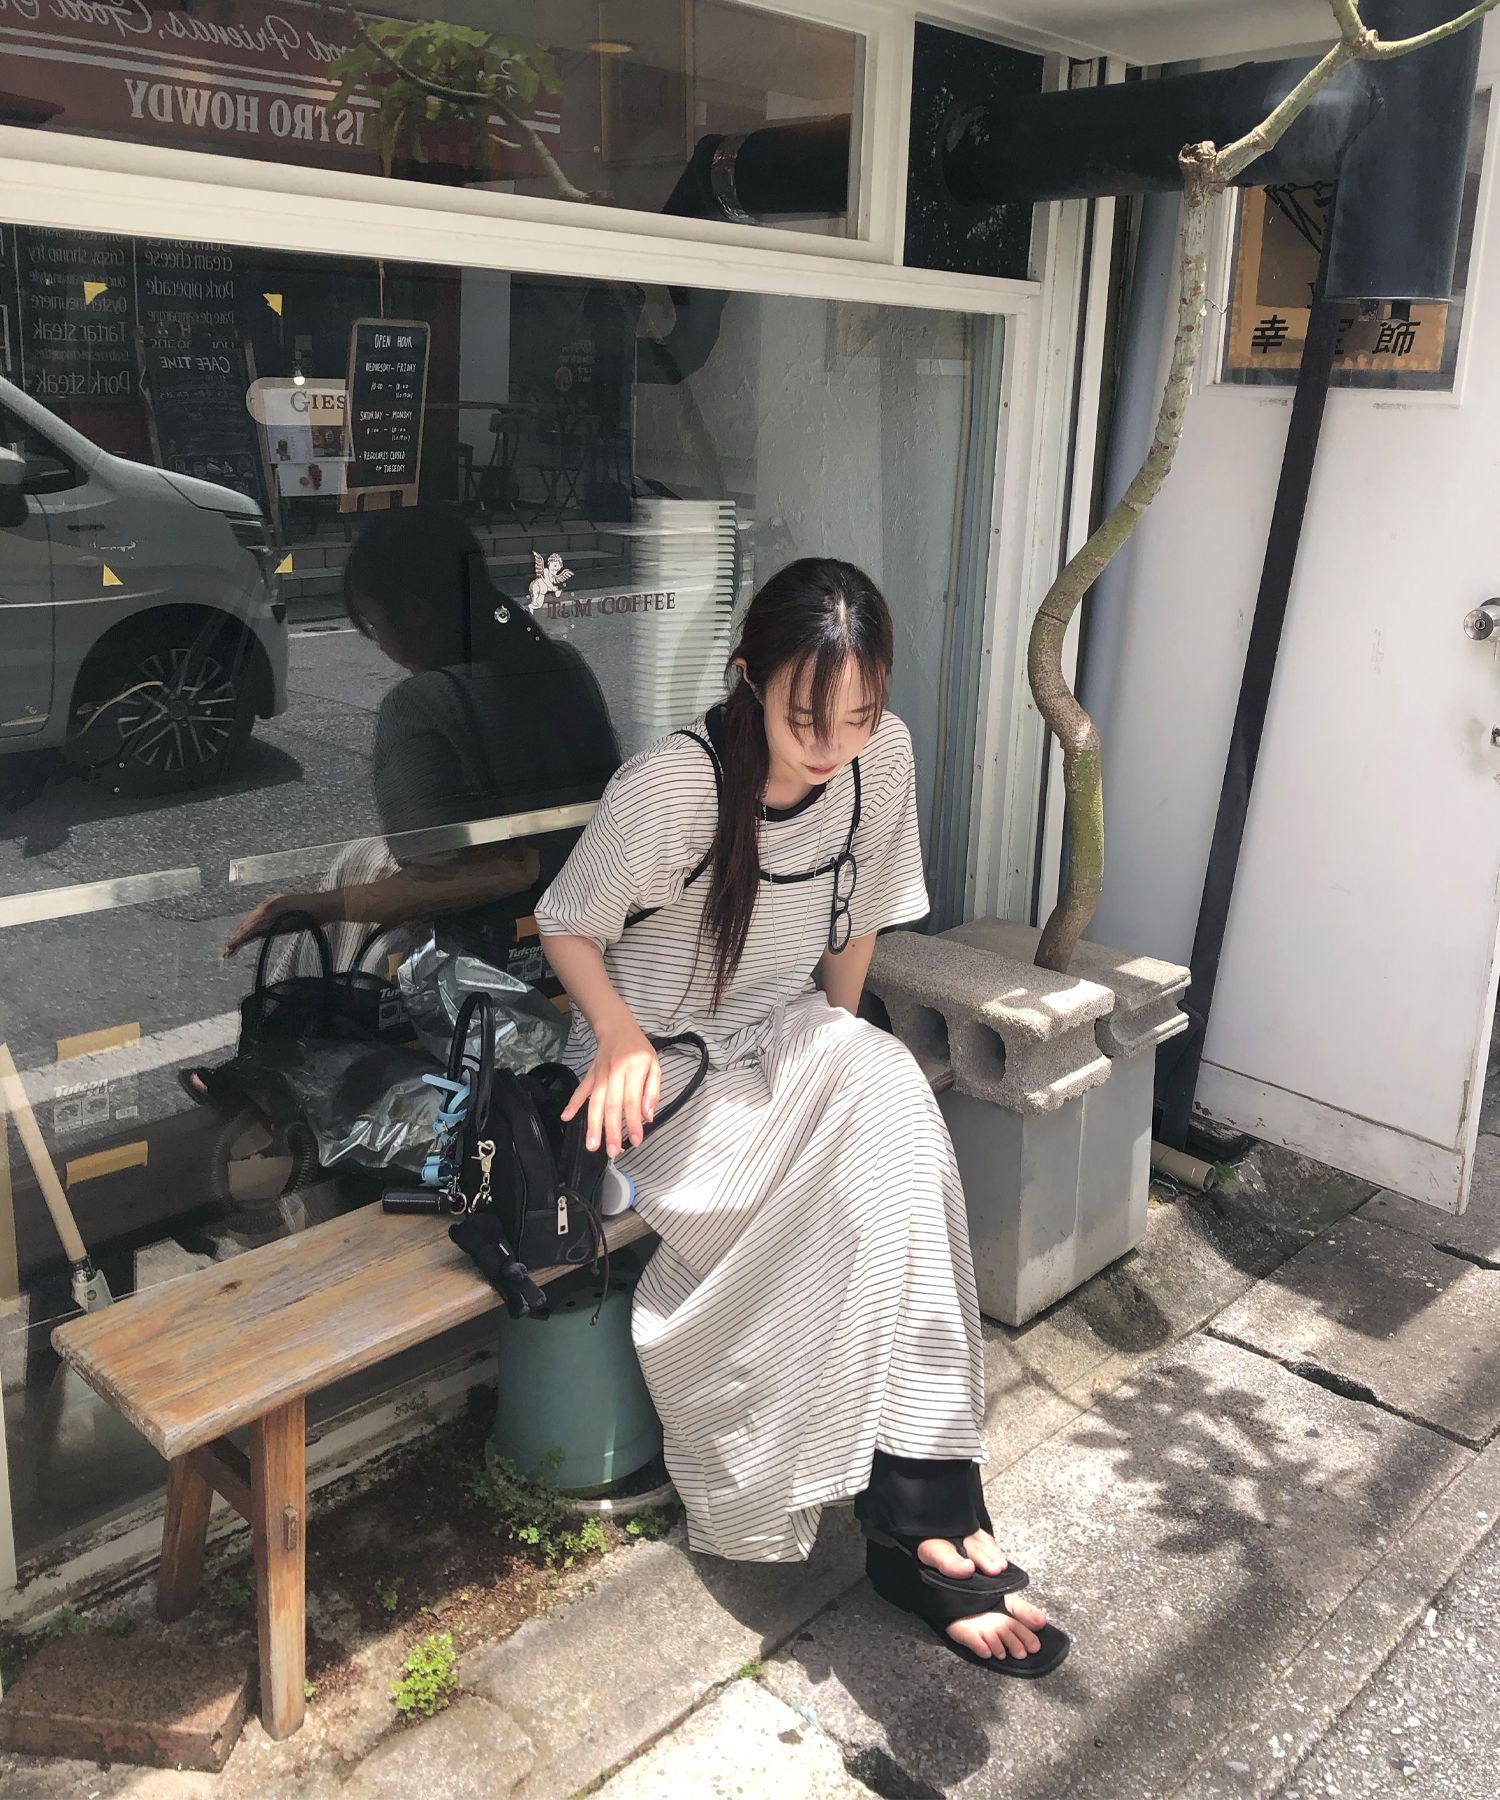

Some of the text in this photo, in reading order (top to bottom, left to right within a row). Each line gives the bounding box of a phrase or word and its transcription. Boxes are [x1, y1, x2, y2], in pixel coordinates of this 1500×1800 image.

[374, 333, 413, 348] OPEN HOUR
[601, 592, 676, 616] COFFEE
